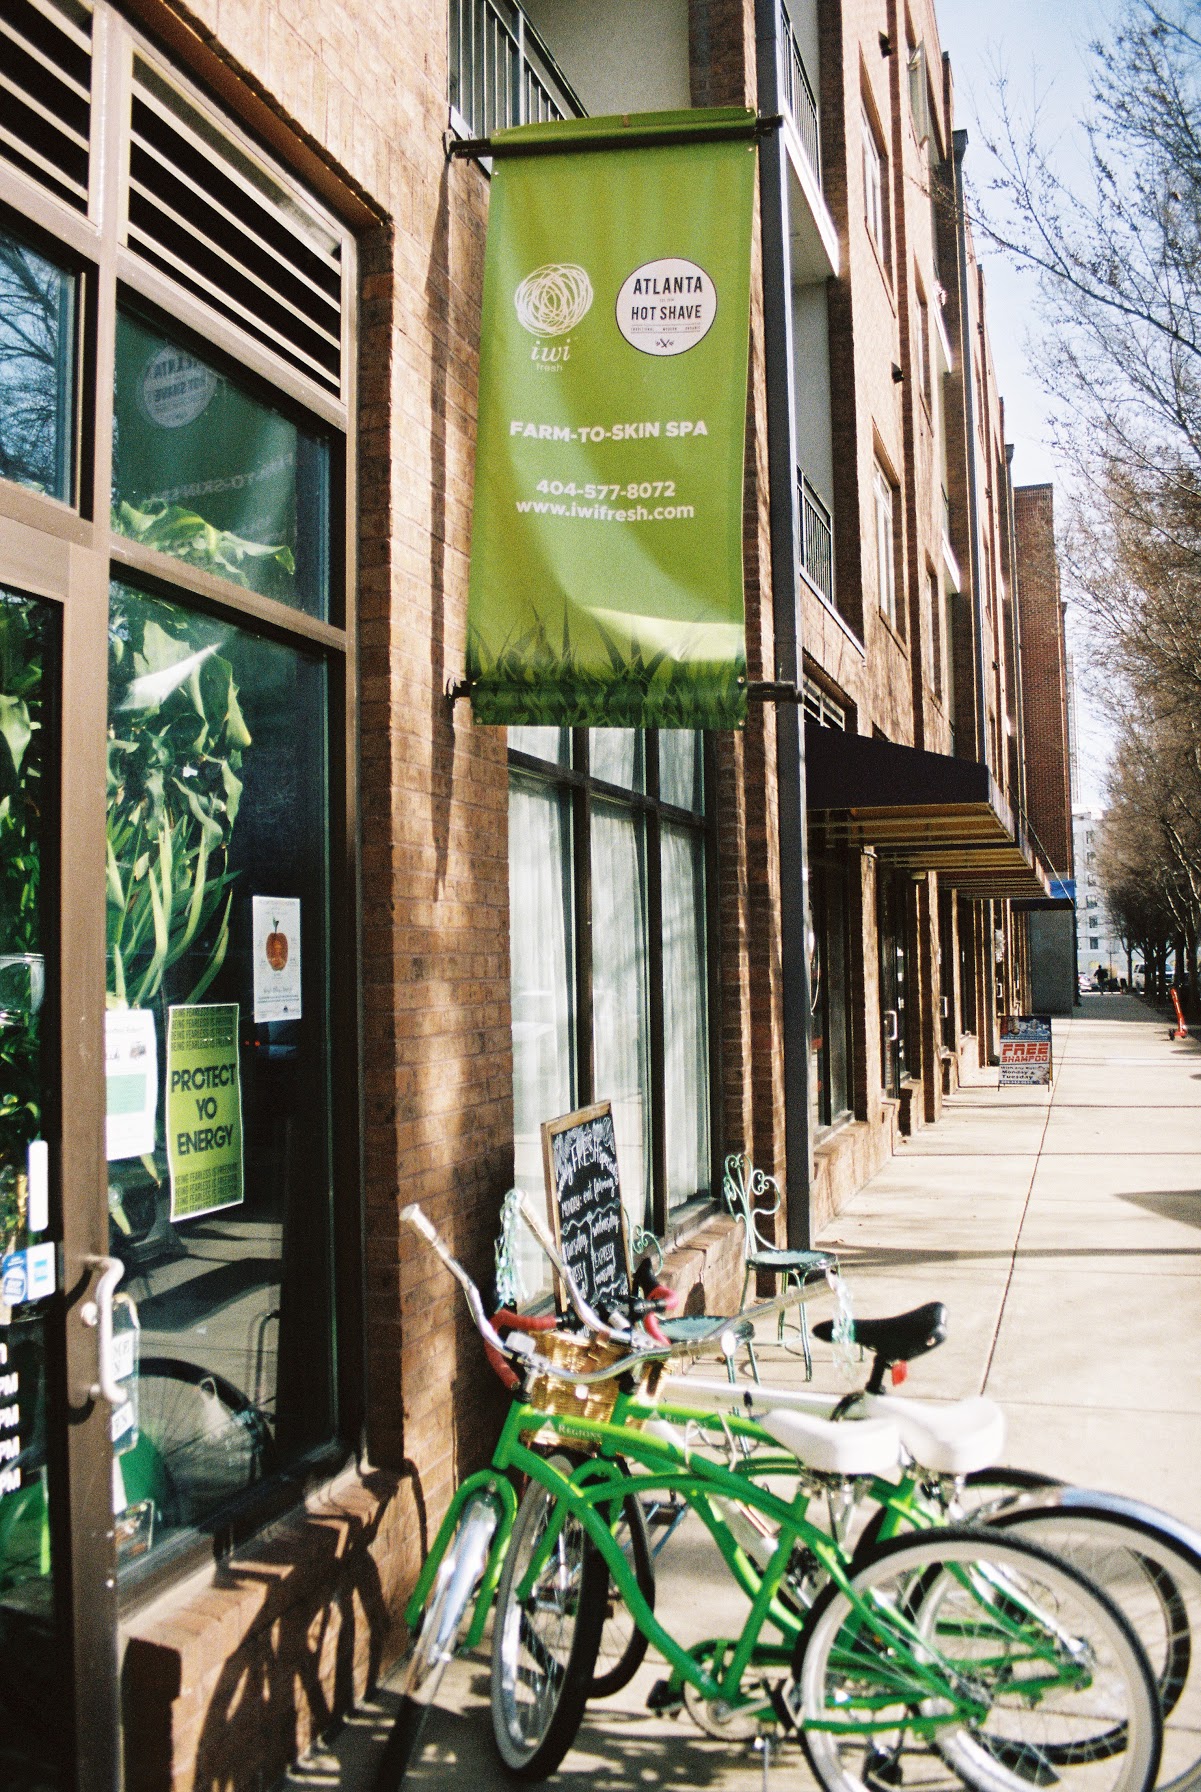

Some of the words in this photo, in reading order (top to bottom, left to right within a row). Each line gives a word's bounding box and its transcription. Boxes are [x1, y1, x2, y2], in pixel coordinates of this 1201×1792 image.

[633, 276, 703, 295] ATLANTA
[631, 306, 657, 320] HOT
[660, 304, 702, 320] SHAVE
[531, 338, 571, 362] iwi
[536, 363, 563, 373] fresh
[509, 420, 660, 443] FARM-TO-SKIN
[665, 420, 708, 437] SPA
[536, 479, 676, 500] 404-577-8072
[515, 500, 695, 522] www.iwifresh.com
[1001, 1055, 1048, 1063] SHAMPOO
[1002, 1043, 1049, 1056] FREE
[171, 1063, 236, 1093] PROTECT
[196, 1097, 218, 1121] YO
[177, 1124, 233, 1156] ENERGY
